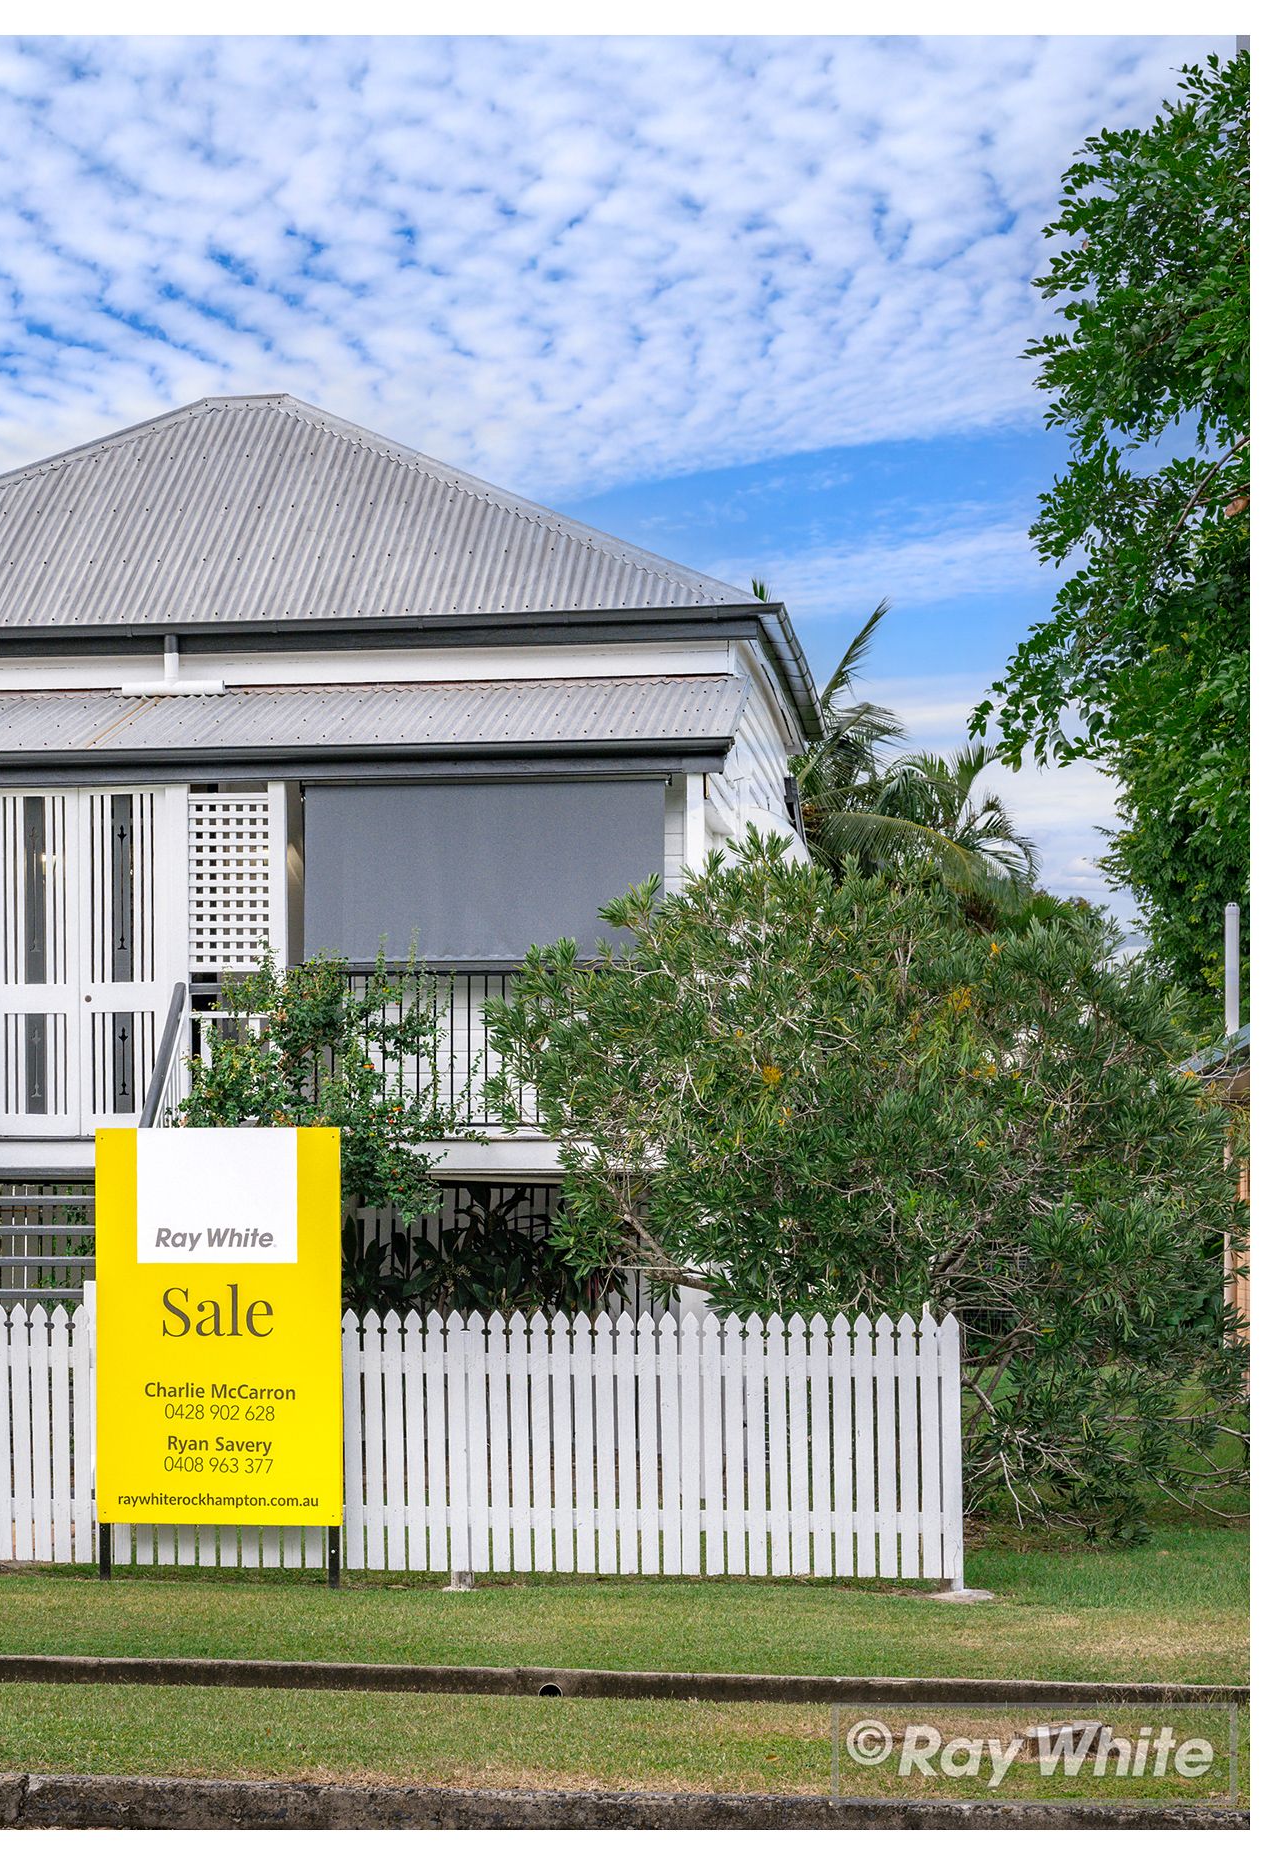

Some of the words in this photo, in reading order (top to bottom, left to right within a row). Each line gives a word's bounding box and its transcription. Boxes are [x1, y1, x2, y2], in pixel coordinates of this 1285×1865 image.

[155, 1227, 202, 1252] Ray
[207, 1227, 274, 1248] White
[162, 1284, 274, 1338] Sale
[144, 1381, 205, 1399] Charlie
[211, 1383, 296, 1401] McCarron
[164, 1403, 204, 1420] 0428
[210, 1404, 239, 1421] 902
[244, 1405, 276, 1422] 628
[167, 1435, 209, 1455] Ryan
[215, 1437, 272, 1456] Savery
[164, 1456, 203, 1473] 0408
[209, 1457, 239, 1474] 963
[244, 1458, 274, 1475] 377
[118, 1492, 319, 1509] raywhiterockhampton.com.au
